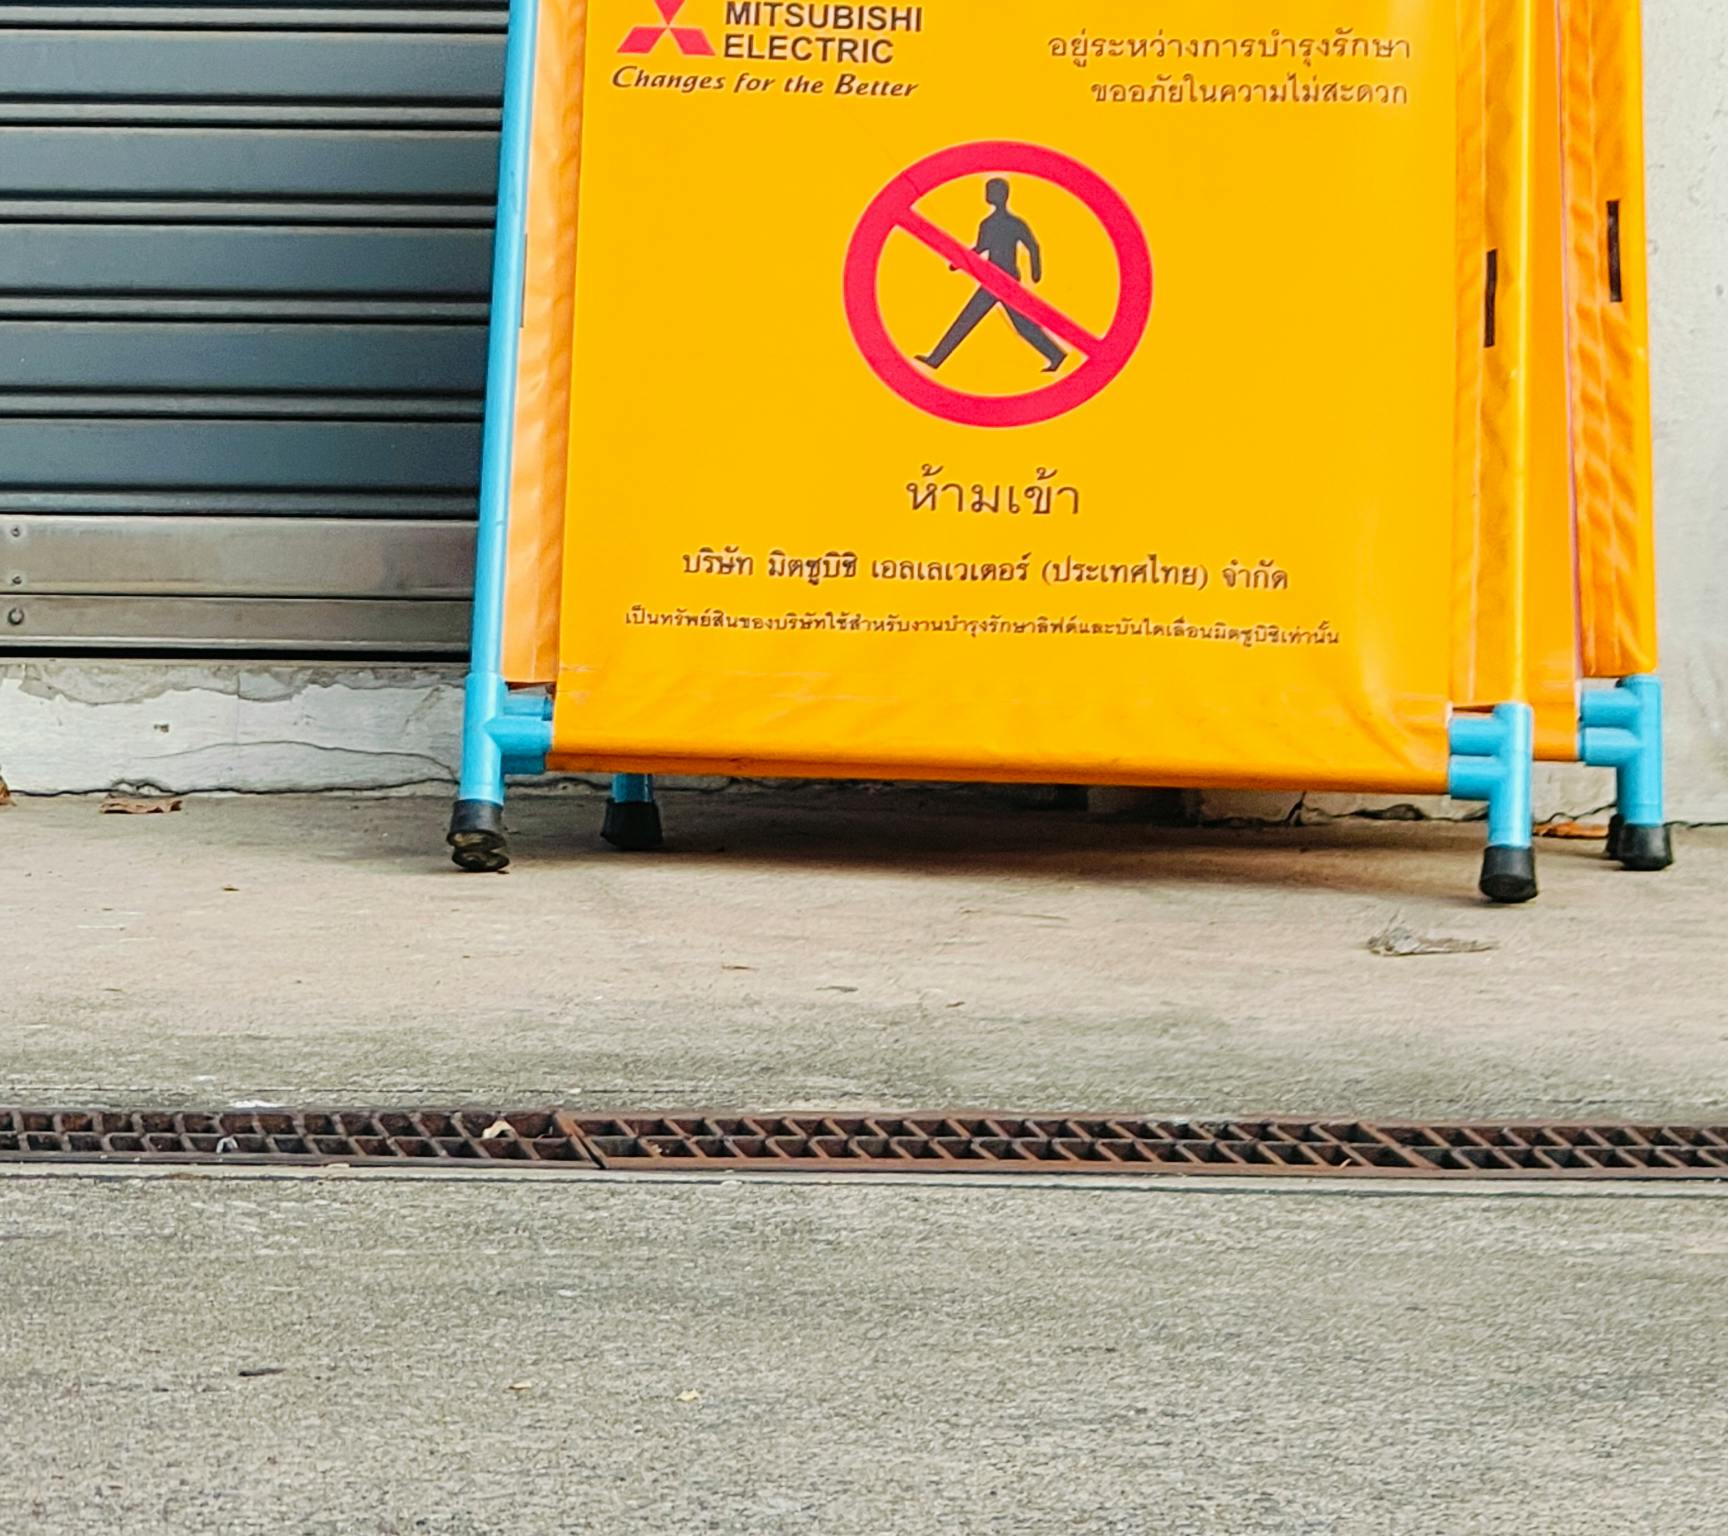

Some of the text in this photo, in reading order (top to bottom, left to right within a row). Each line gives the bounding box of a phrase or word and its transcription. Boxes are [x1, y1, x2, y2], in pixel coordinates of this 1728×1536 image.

[725, 0, 923, 33] MITSUBISHI
[723, 33, 896, 65] ELECTRIC
[1047, 27, 1411, 68] อยู่ระหว่างการบำรุงรักษา
[612, 65, 919, 97] Changes for the Better
[1090, 72, 1408, 105] ขออภัยในความไม่สะดวก
[905, 463, 1080, 515] ห้ามเข้า
[682, 545, 754, 576] บริษัท
[871, 552, 1032, 582] เอลเลเวเตอร์
[1041, 554, 1209, 591] (ประเทศไทย)
[1222, 559, 1289, 590] จำกัด
